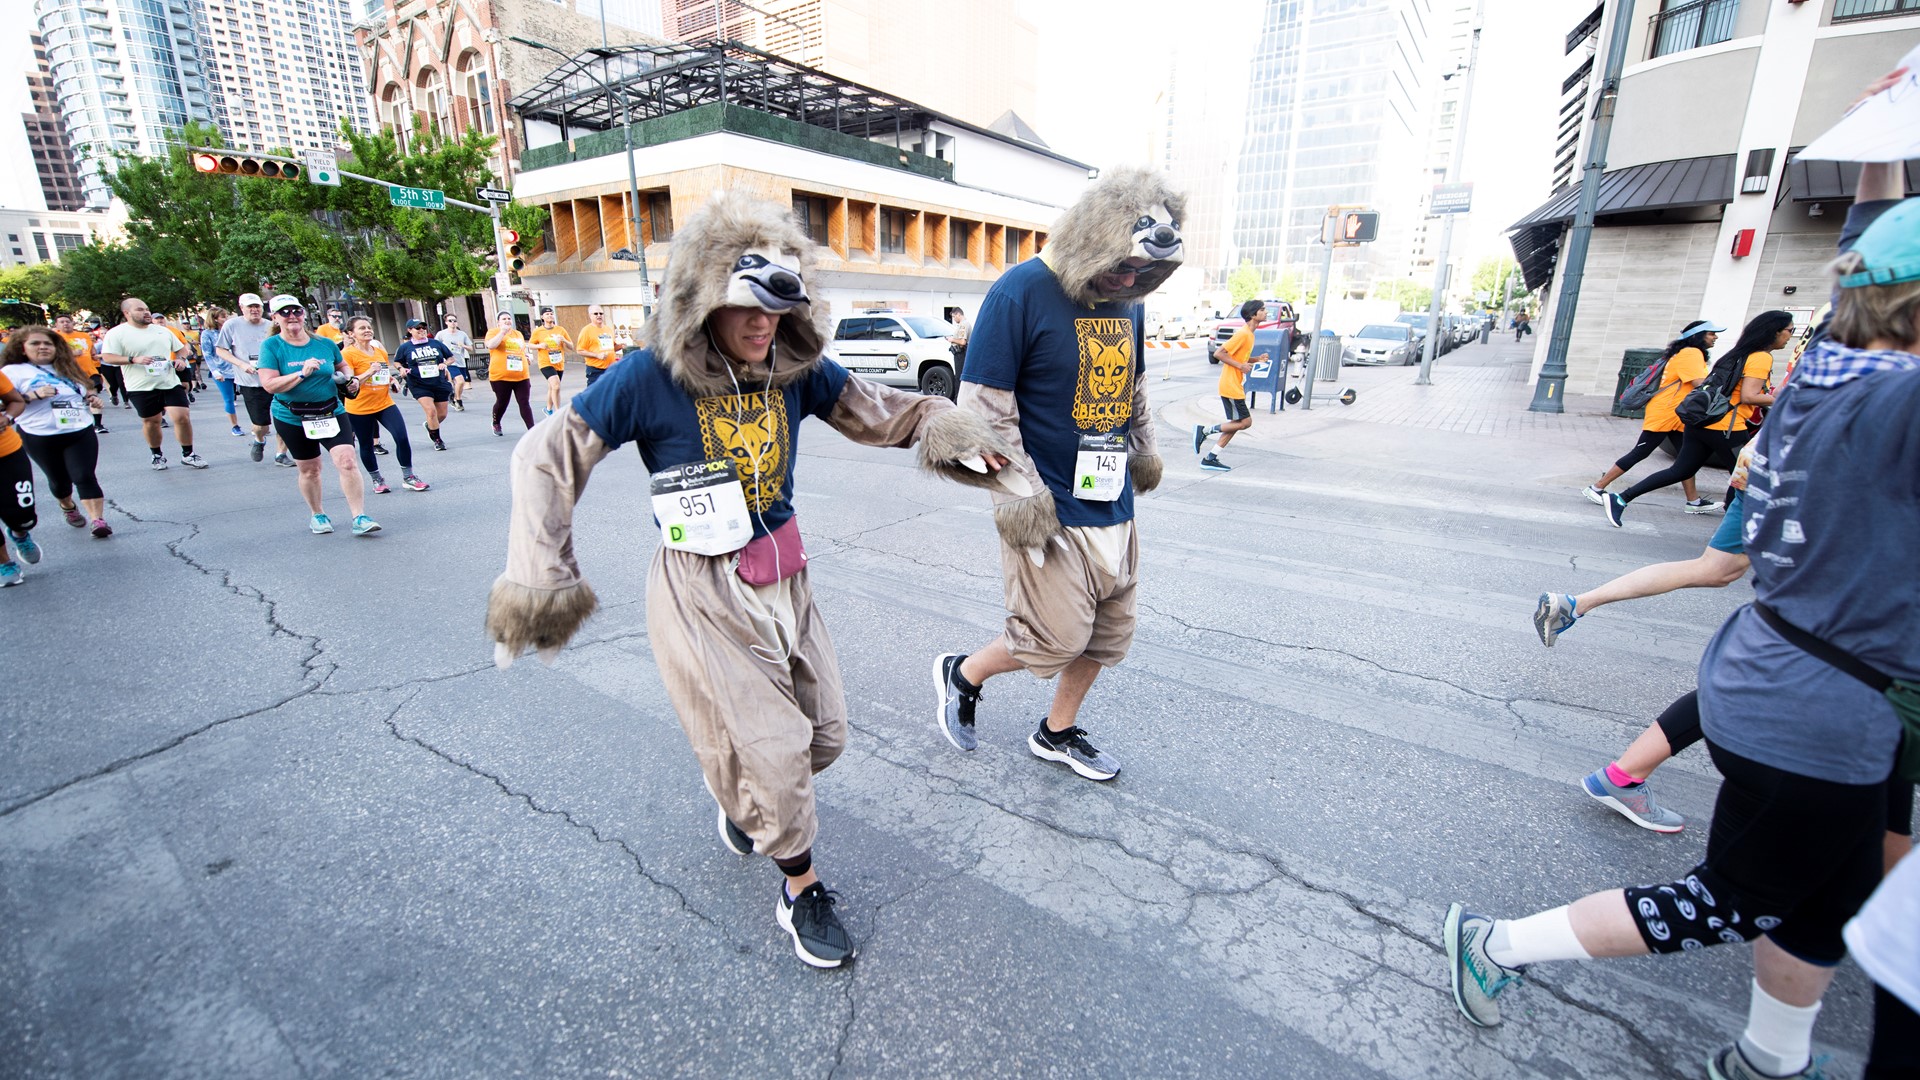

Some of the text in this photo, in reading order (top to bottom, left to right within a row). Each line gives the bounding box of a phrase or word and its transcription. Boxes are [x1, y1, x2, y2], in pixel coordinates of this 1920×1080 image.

[313, 158, 331, 166] YIELD
[399, 188, 434, 202] 5th ST
[1432, 198, 1470, 206] AMERICAN
[1436, 192, 1469, 200] MEXICAN
[1091, 319, 1124, 334] VIVA
[720, 394, 766, 414] VIVA
[1080, 402, 1128, 418] BECKER
[312, 421, 330, 429] 1515
[685, 460, 728, 476] CAP10K
[1096, 455, 1117, 472] 143
[1081, 476, 1093, 488] A
[679, 492, 716, 517] 951
[670, 526, 682, 541] D
